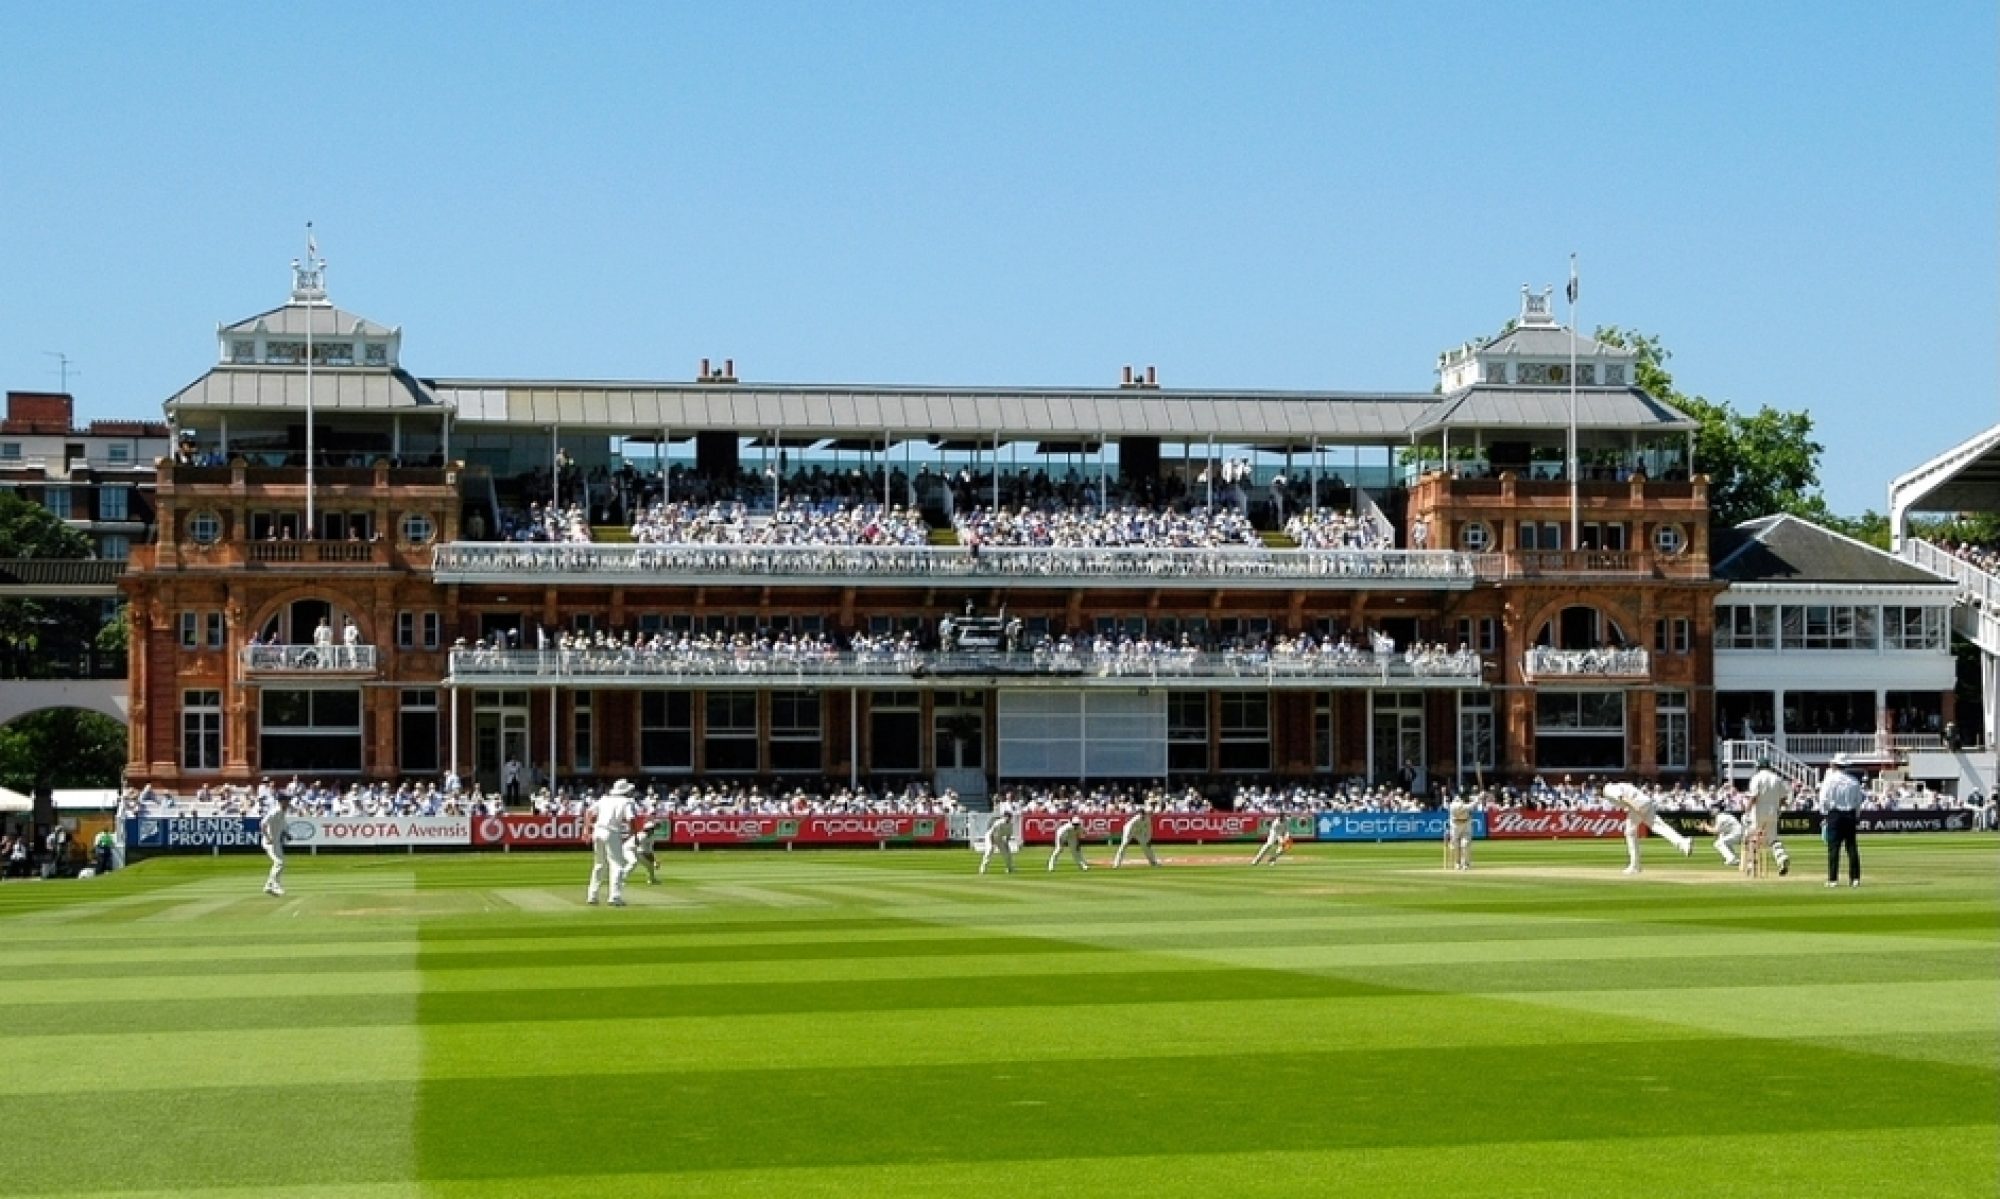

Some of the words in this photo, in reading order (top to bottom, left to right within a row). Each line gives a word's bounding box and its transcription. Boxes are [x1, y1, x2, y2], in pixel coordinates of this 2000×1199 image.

[169, 817, 244, 831] FRIENDS
[322, 822, 401, 838] TOYOTA
[407, 822, 468, 838] Avensis
[507, 817, 587, 839] vodaf
[674, 820, 772, 837] npower
[812, 819, 909, 837] npower
[1159, 817, 1254, 834] npower
[1345, 816, 1482, 833] betfair.c
[1491, 811, 1550, 832] Red
[1874, 818, 1941, 831] AIRWAYS
